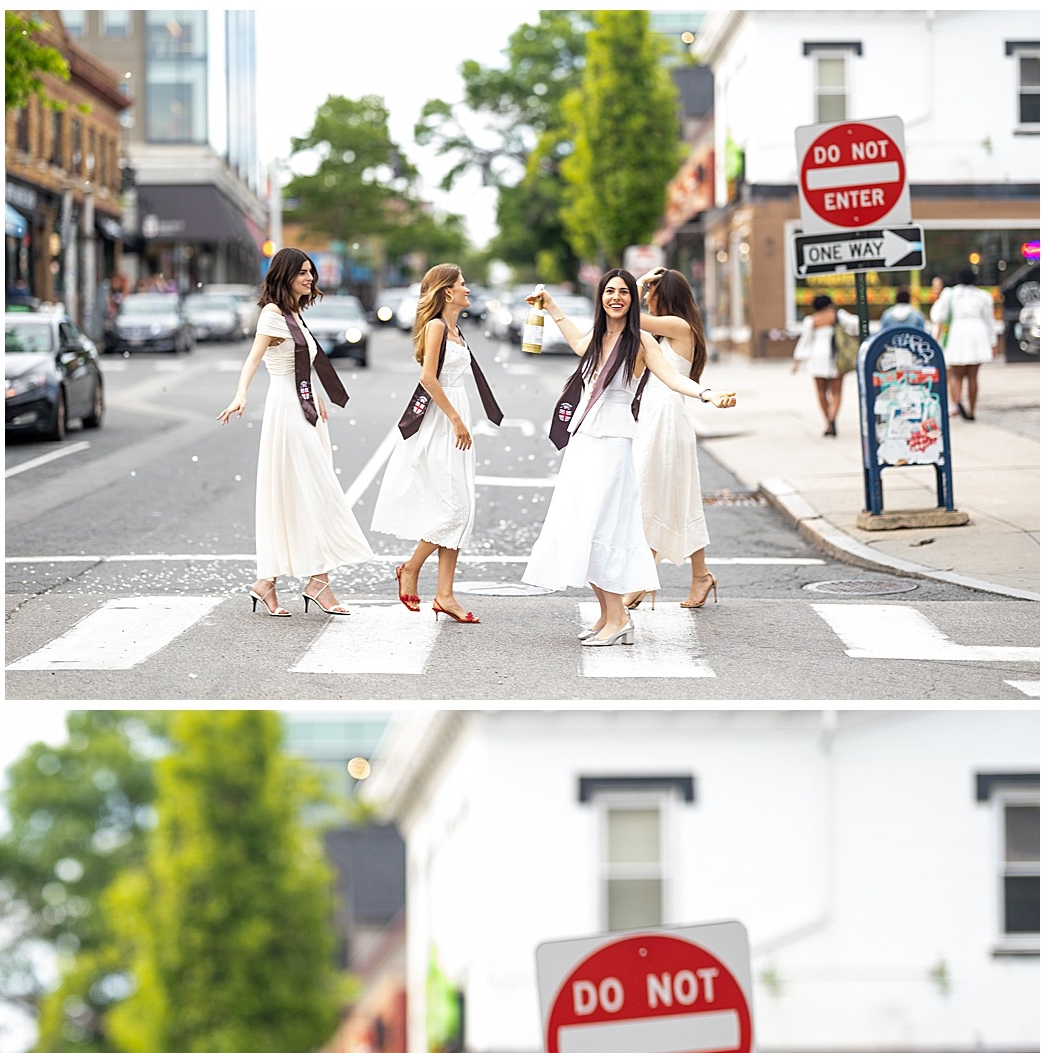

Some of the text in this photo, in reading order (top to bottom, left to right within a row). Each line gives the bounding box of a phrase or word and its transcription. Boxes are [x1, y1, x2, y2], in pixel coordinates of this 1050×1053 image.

[813, 140, 889, 165] DO NOT
[824, 188, 885, 211] ENTER
[808, 241, 883, 262] ONE WAY
[572, 968, 719, 1016] DO NOT
